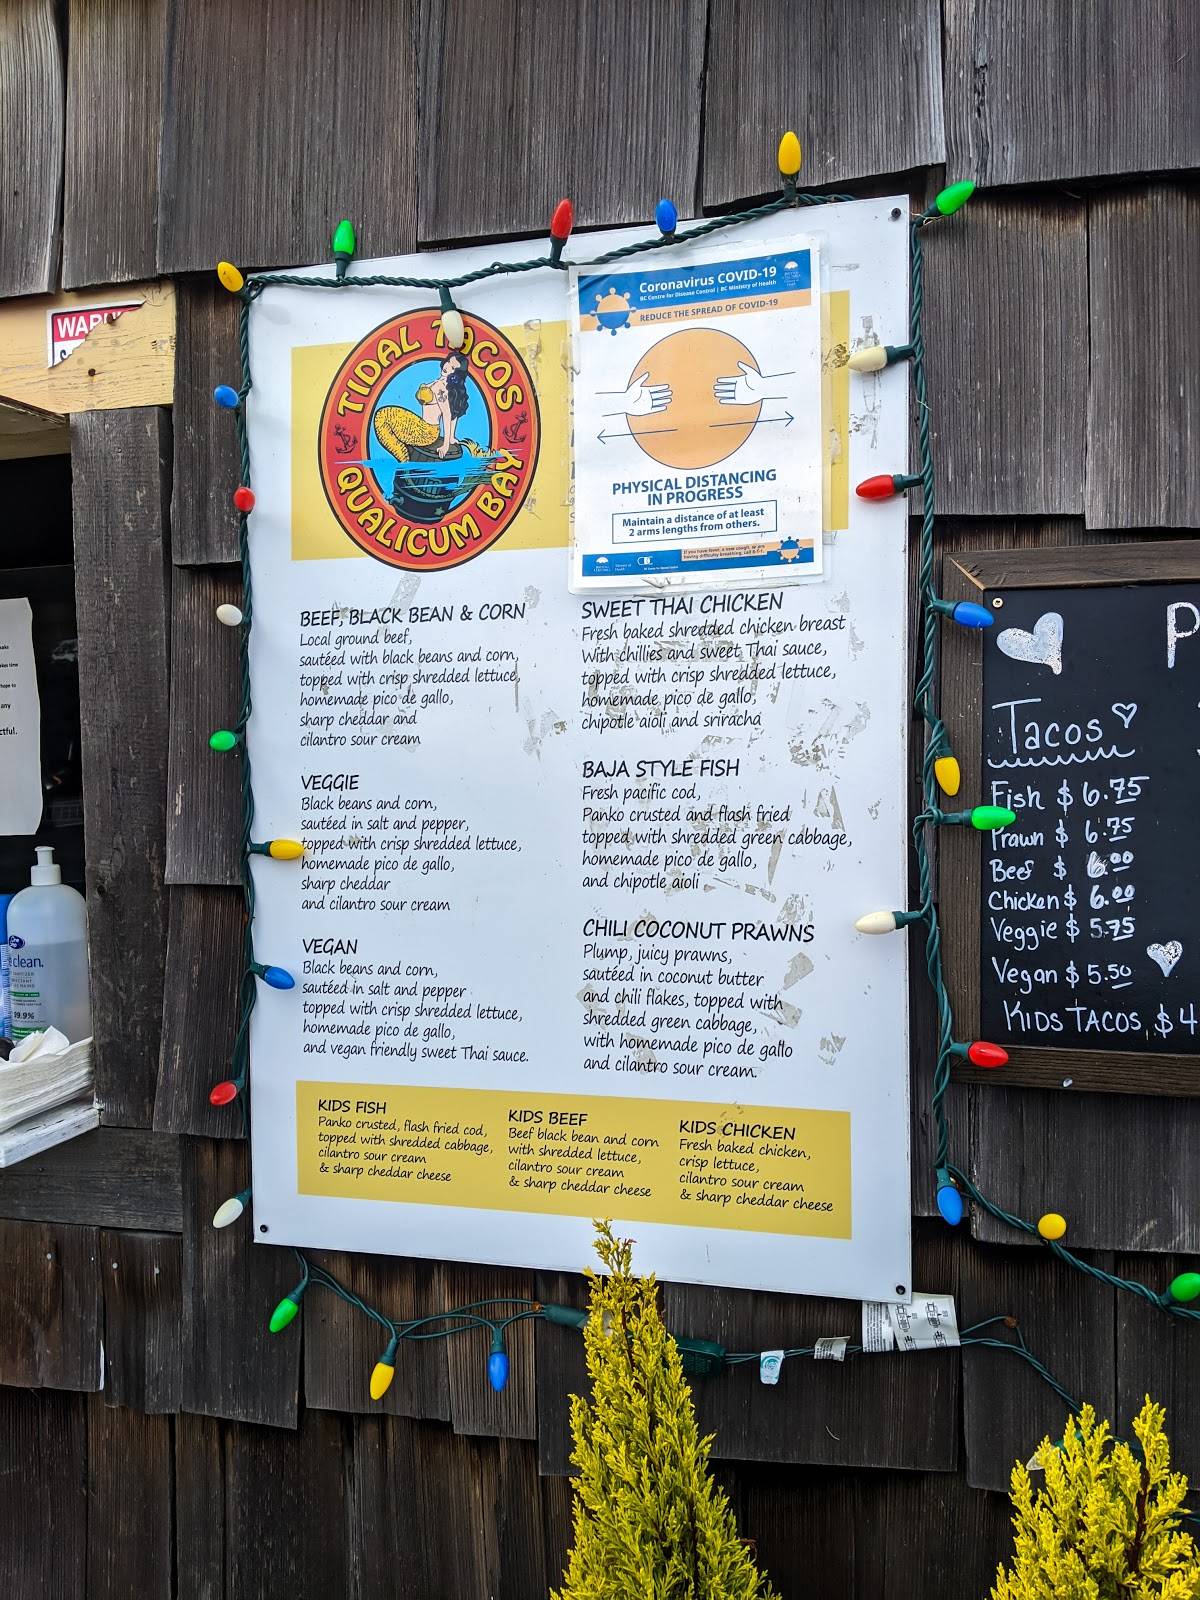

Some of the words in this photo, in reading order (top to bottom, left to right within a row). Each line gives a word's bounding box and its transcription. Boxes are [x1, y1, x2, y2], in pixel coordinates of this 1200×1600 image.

[639, 274, 714, 293] Coronavirus
[717, 265, 777, 283] COVID-19
[729, 282, 750, 291] Ministry
[759, 279, 777, 287] Health
[675, 290, 694, 298] Disease
[696, 287, 716, 295] Control
[640, 312, 672, 322] REDUCE
[674, 309, 689, 318] THE
[691, 306, 722, 316] SPREAD
[725, 304, 737, 312] OF
[739, 299, 778, 310] COVID-19
[338, 326, 422, 416] TIDAL
[612, 477, 682, 495] PHYSICAL
[685, 469, 777, 489] DISTANCING
[337, 465, 481, 556] QUALICUM
[476, 448, 523, 520] BAY
[648, 494, 662, 505] IN
[666, 486, 743, 505] PROGRESS
[622, 516, 664, 527] Maintain
[674, 513, 715, 523] distance
[716, 511, 727, 520] of
[729, 511, 739, 519] at
[741, 508, 764, 517] least
[629, 528, 635, 536] 2
[637, 527, 660, 536] arms
[662, 523, 698, 536] lengths
[700, 522, 723, 532] from
[725, 519, 760, 530] others.
[300, 610, 343, 627] BEEF,
[349, 607, 403, 625] BLACK
[408, 606, 453, 623] BEAN
[459, 605, 473, 621] &
[479, 603, 526, 620] CORN
[581, 600, 645, 619] SWEET
[650, 596, 693, 615] THAI
[700, 592, 783, 614] CHICKEN
[581, 623, 618, 641] Fresh
[623, 622, 664, 639] baked
[669, 619, 734, 637] shredded
[739, 616, 794, 636] chicken
[799, 614, 846, 632] breast
[300, 631, 331, 646] Local
[335, 630, 379, 650] ground
[384, 628, 412, 645] beef,
[350, 651, 378, 664] with
[383, 649, 414, 664] black
[418, 649, 453, 664] beans
[457, 647, 482, 662] and
[486, 651, 519, 663] corn,
[992, 698, 1103, 754] Tacos
[582, 760, 630, 778] BAJA
[636, 759, 693, 777] STYLE
[700, 759, 739, 777] FISH
[301, 774, 359, 791] VEGGIE
[991, 780, 1045, 810] Fish
[1057, 779, 1073, 816] $
[1083, 776, 1150, 807] 6.75
[582, 807, 624, 822] Panko
[629, 806, 678, 822] crusted
[686, 805, 714, 821] and
[718, 805, 751, 821] flash
[756, 805, 790, 822] fried
[301, 836, 344, 854] topped
[349, 835, 377, 850] with
[380, 836, 409, 855] crisp
[414, 835, 470, 851] shredded
[476, 836, 522, 852] lettuce,
[991, 827, 1044, 851] Prawn
[1055, 819, 1069, 848] $
[1084, 817, 1135, 843] 6.75
[989, 859, 1034, 882] Beef
[1053, 856, 1067, 880] $
[1087, 851, 1134, 878] 6.00
[988, 890, 1060, 911] Chicken
[1064, 884, 1078, 911] $
[1090, 885, 1135, 909] 6.00
[583, 919, 627, 937] CHILI
[633, 920, 726, 940] COCONUT
[731, 923, 815, 943] PRAWNS
[990, 917, 1058, 951] Veggie
[1066, 913, 1080, 943] $
[1090, 917, 1136, 939] 5.75
[302, 938, 358, 956] VEGAN
[583, 944, 633, 962] Plump,
[635, 944, 669, 966] juicy
[674, 949, 733, 966] prawns,
[13, 954, 44, 968] clean.
[991, 957, 1058, 994] Vegan
[1066, 960, 1079, 988] $
[1087, 964, 1132, 984] 5.50
[1003, 1000, 1064, 1032] KIDS
[1065, 1007, 1142, 1032] TACOS
[1154, 1004, 1173, 1038] $
[303, 1040, 327, 1054] and
[331, 1042, 366, 1059] vegan
[370, 1041, 417, 1061] friendly
[421, 1046, 457, 1060] sweet
[460, 1046, 489, 1061] Thai
[493, 1049, 529, 1062] sauce.
[318, 1099, 351, 1112] KIDS
[356, 1101, 387, 1114] FISH
[509, 1109, 543, 1123] KIDS
[549, 1112, 588, 1126] BEEF
[318, 1116, 352, 1128] Panko
[356, 1119, 401, 1132] crusted,
[404, 1120, 429, 1133] flash
[433, 1121, 459, 1134] fried
[464, 1124, 488, 1138] cod,
[509, 1127, 534, 1140] Beef
[537, 1129, 567, 1142] black
[571, 1130, 600, 1143] bean
[604, 1132, 627, 1145] and
[632, 1136, 659, 1147] corn
[679, 1120, 716, 1135] KIDS
[722, 1122, 796, 1140] CHICKEN
[679, 1139, 713, 1152] Fresh
[717, 1140, 754, 1154] baked
[759, 1144, 811, 1160] chicken,
[679, 1155, 708, 1171] crisp
[713, 1157, 760, 1173] lettuce,
